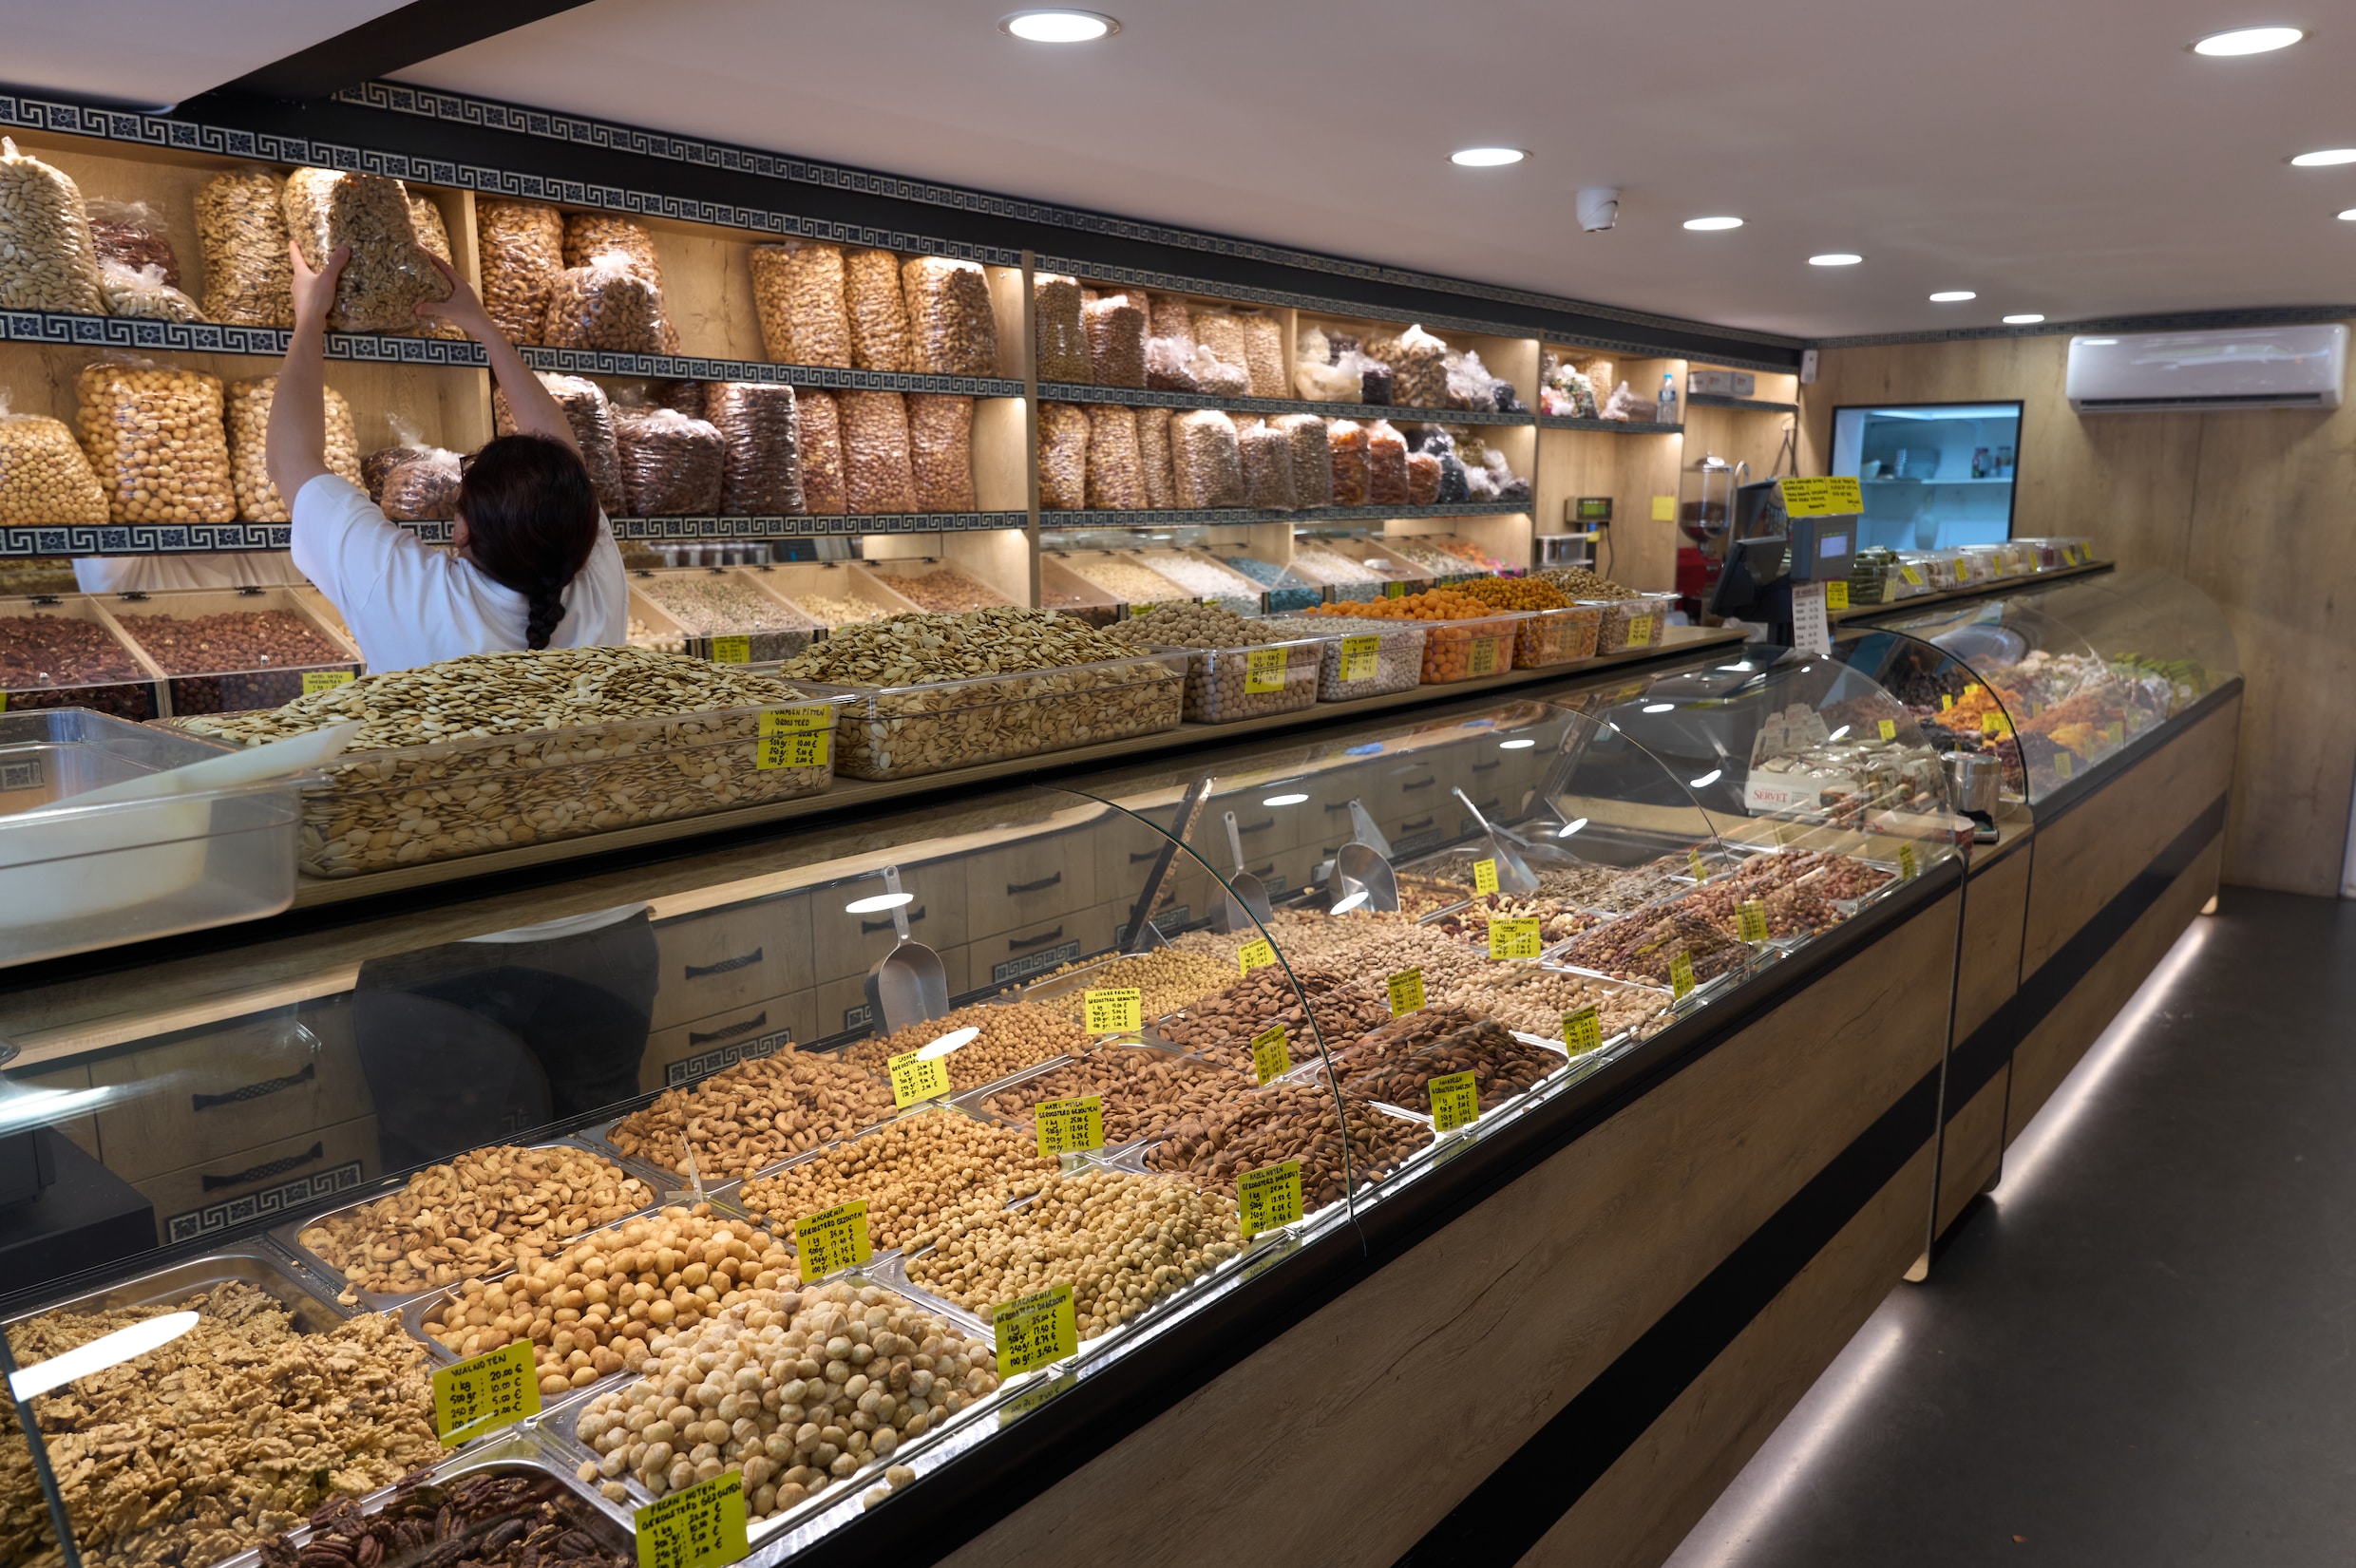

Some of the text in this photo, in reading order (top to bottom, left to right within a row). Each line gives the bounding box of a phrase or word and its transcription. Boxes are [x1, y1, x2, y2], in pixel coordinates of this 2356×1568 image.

[1754, 790, 1787, 803] SERVET
[450, 1364, 522, 1391] 1 kg 20.00 €
[450, 1378, 522, 1404] 500 gr 10.00 €
[451, 1389, 522, 1418] 250 gr 5.00 €
[452, 1421, 464, 1430] 100
[494, 1407, 510, 1417] 2.00
[513, 1402, 522, 1411] €
